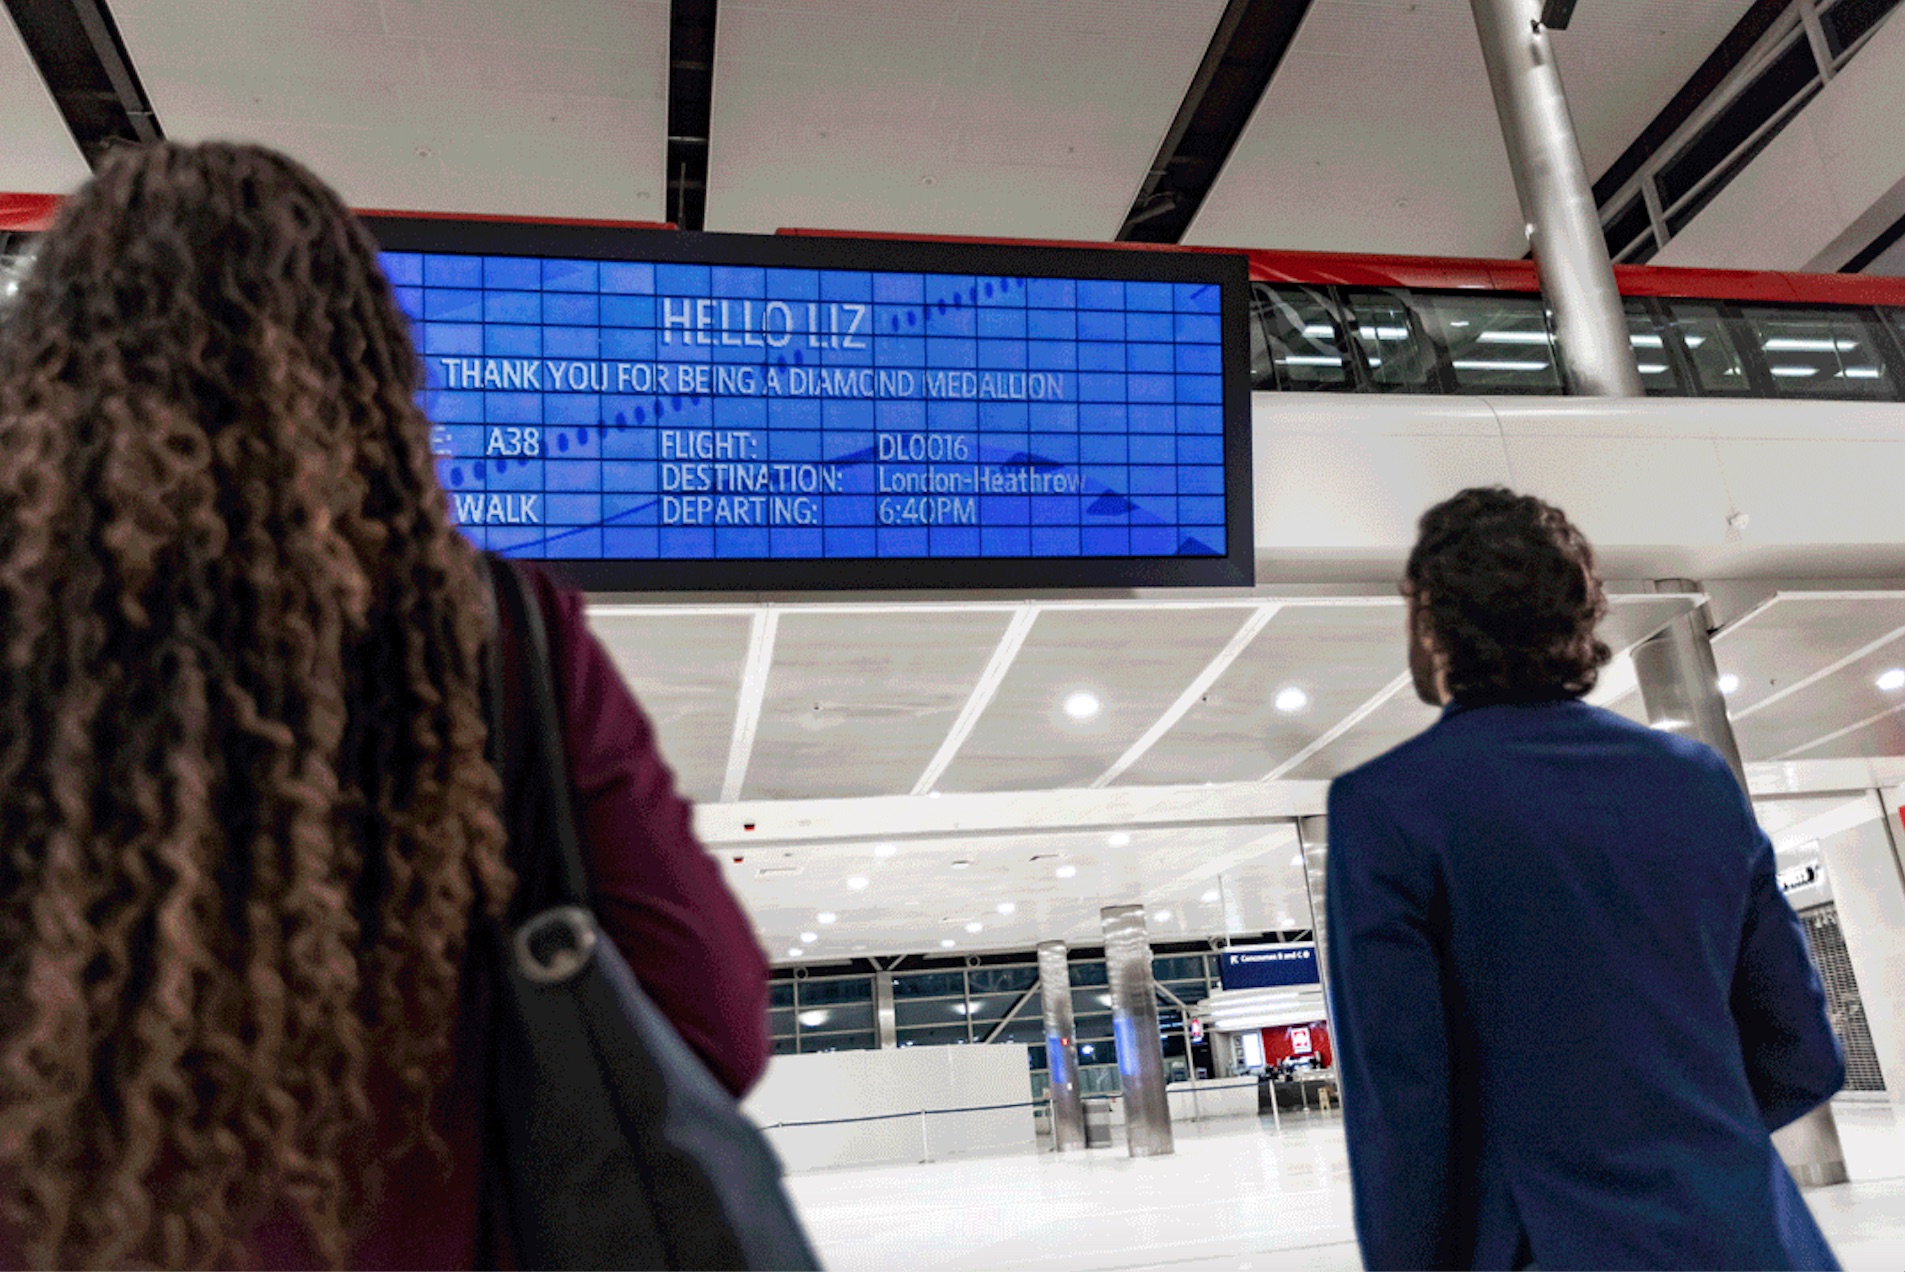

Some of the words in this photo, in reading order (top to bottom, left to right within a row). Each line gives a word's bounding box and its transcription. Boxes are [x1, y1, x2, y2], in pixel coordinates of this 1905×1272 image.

[663, 298, 793, 347] HELLO
[808, 303, 867, 349] LIZ
[441, 358, 541, 389] THANK
[546, 361, 608, 391] YOU
[617, 363, 671, 393] FOR
[677, 365, 755, 395] BEING
[762, 367, 782, 395] A
[789, 367, 915, 397] DIAMOND
[922, 369, 1064, 400] MEDALLION
[486, 427, 540, 456] A38
[661, 430, 757, 459] FLIGHT:
[879, 433, 969, 461] DL0016
[662, 463, 843, 492] DESTINATION:
[879, 465, 1086, 494] London-Heathrow
[453, 494, 539, 523] WALK
[663, 496, 818, 525] DEPARTING:
[879, 497, 977, 525] 6:40PM
